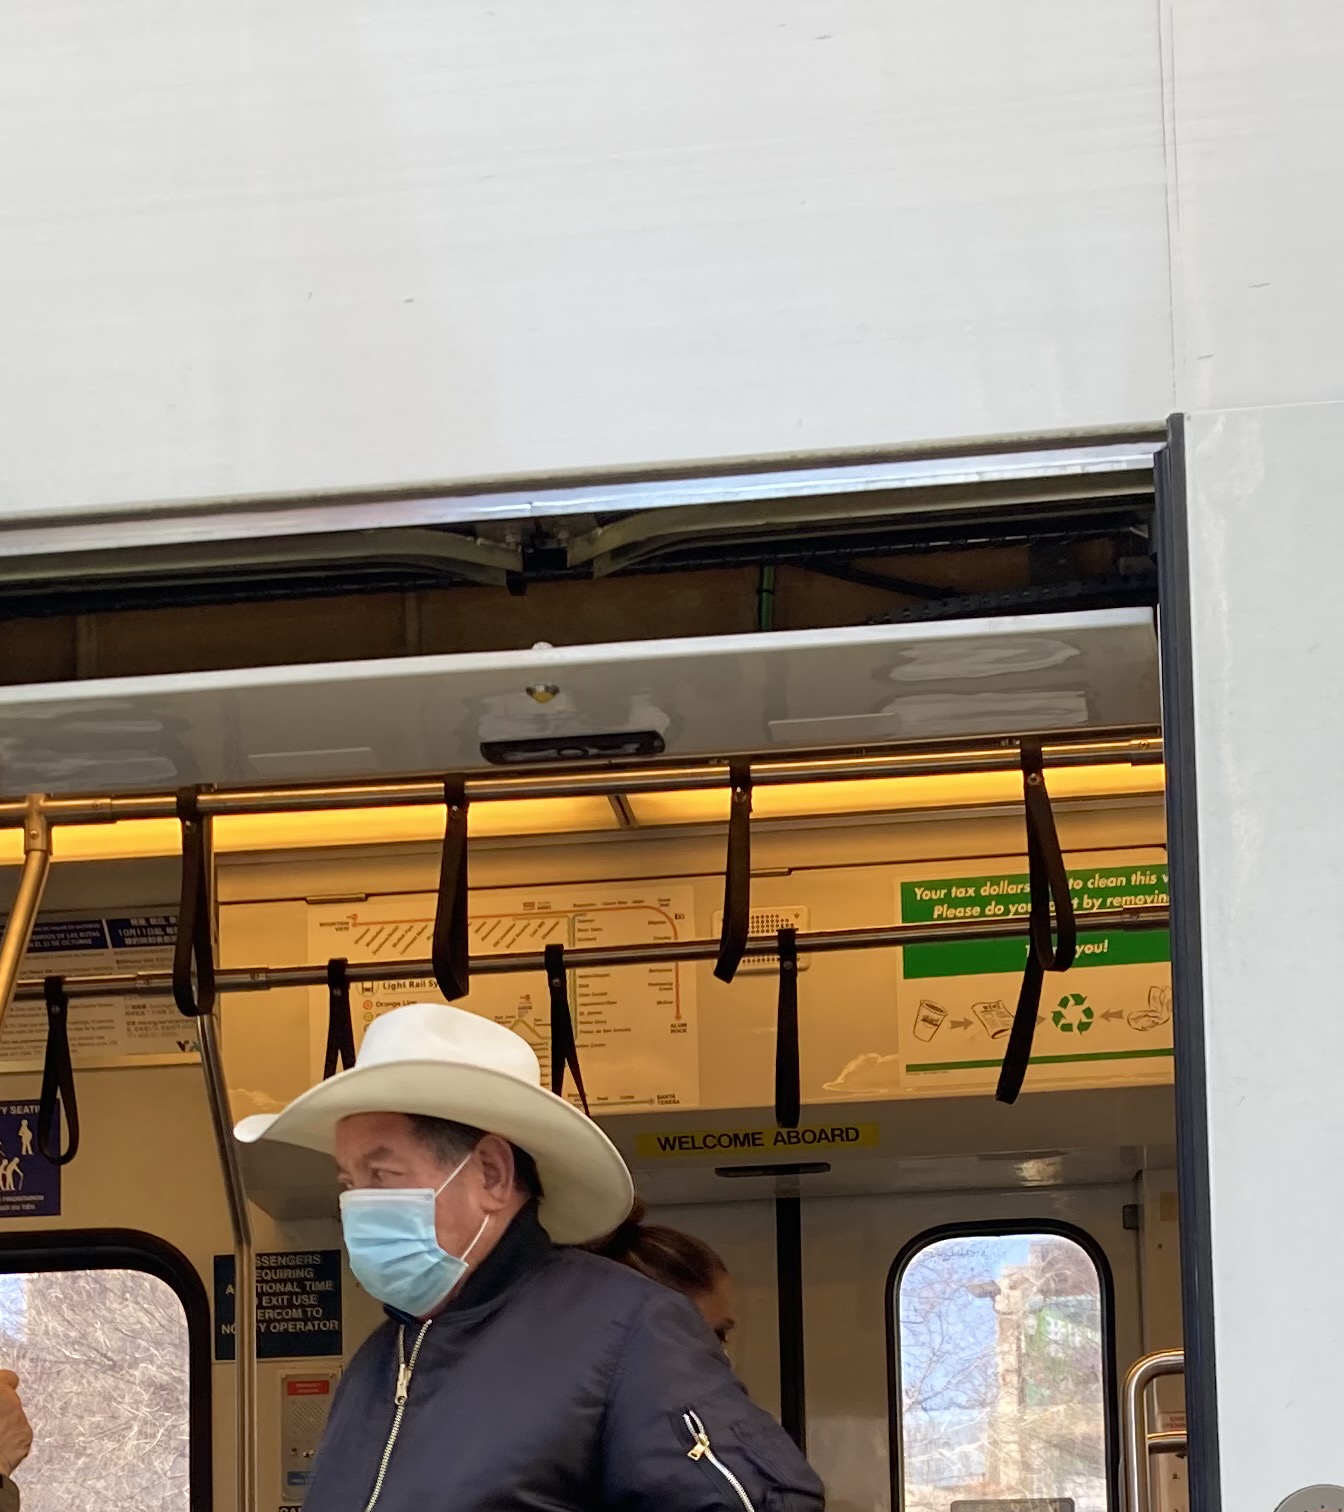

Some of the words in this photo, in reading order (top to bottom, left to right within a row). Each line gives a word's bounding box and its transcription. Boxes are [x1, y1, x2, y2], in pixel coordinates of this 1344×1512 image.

[914, 887, 947, 900] Your
[951, 885, 975, 898] tax
[980, 880, 1030, 897] dollars
[1069, 877, 1083, 889] to
[1087, 873, 1126, 889] clean
[1131, 871, 1157, 885] this
[933, 904, 981, 919] Please
[985, 901, 1004, 916] do
[1083, 894, 1102, 911] by
[1106, 890, 1169, 907] removin
[656, 1131, 765, 1152] WELCOME
[772, 1126, 861, 1147] ABOARD
[256, 1254, 322, 1267] SSENGERS
[256, 1268, 315, 1281] EQUIRING
[225, 1281, 301, 1296] ATIONAL
[305, 1280, 336, 1292] TIME
[262, 1295, 290, 1307] EXIT
[293, 1294, 319, 1305] USE
[258, 1309, 303, 1321] ERCOM
[306, 1307, 323, 1318] TO
[270, 1319, 340, 1333] OPERATOR
